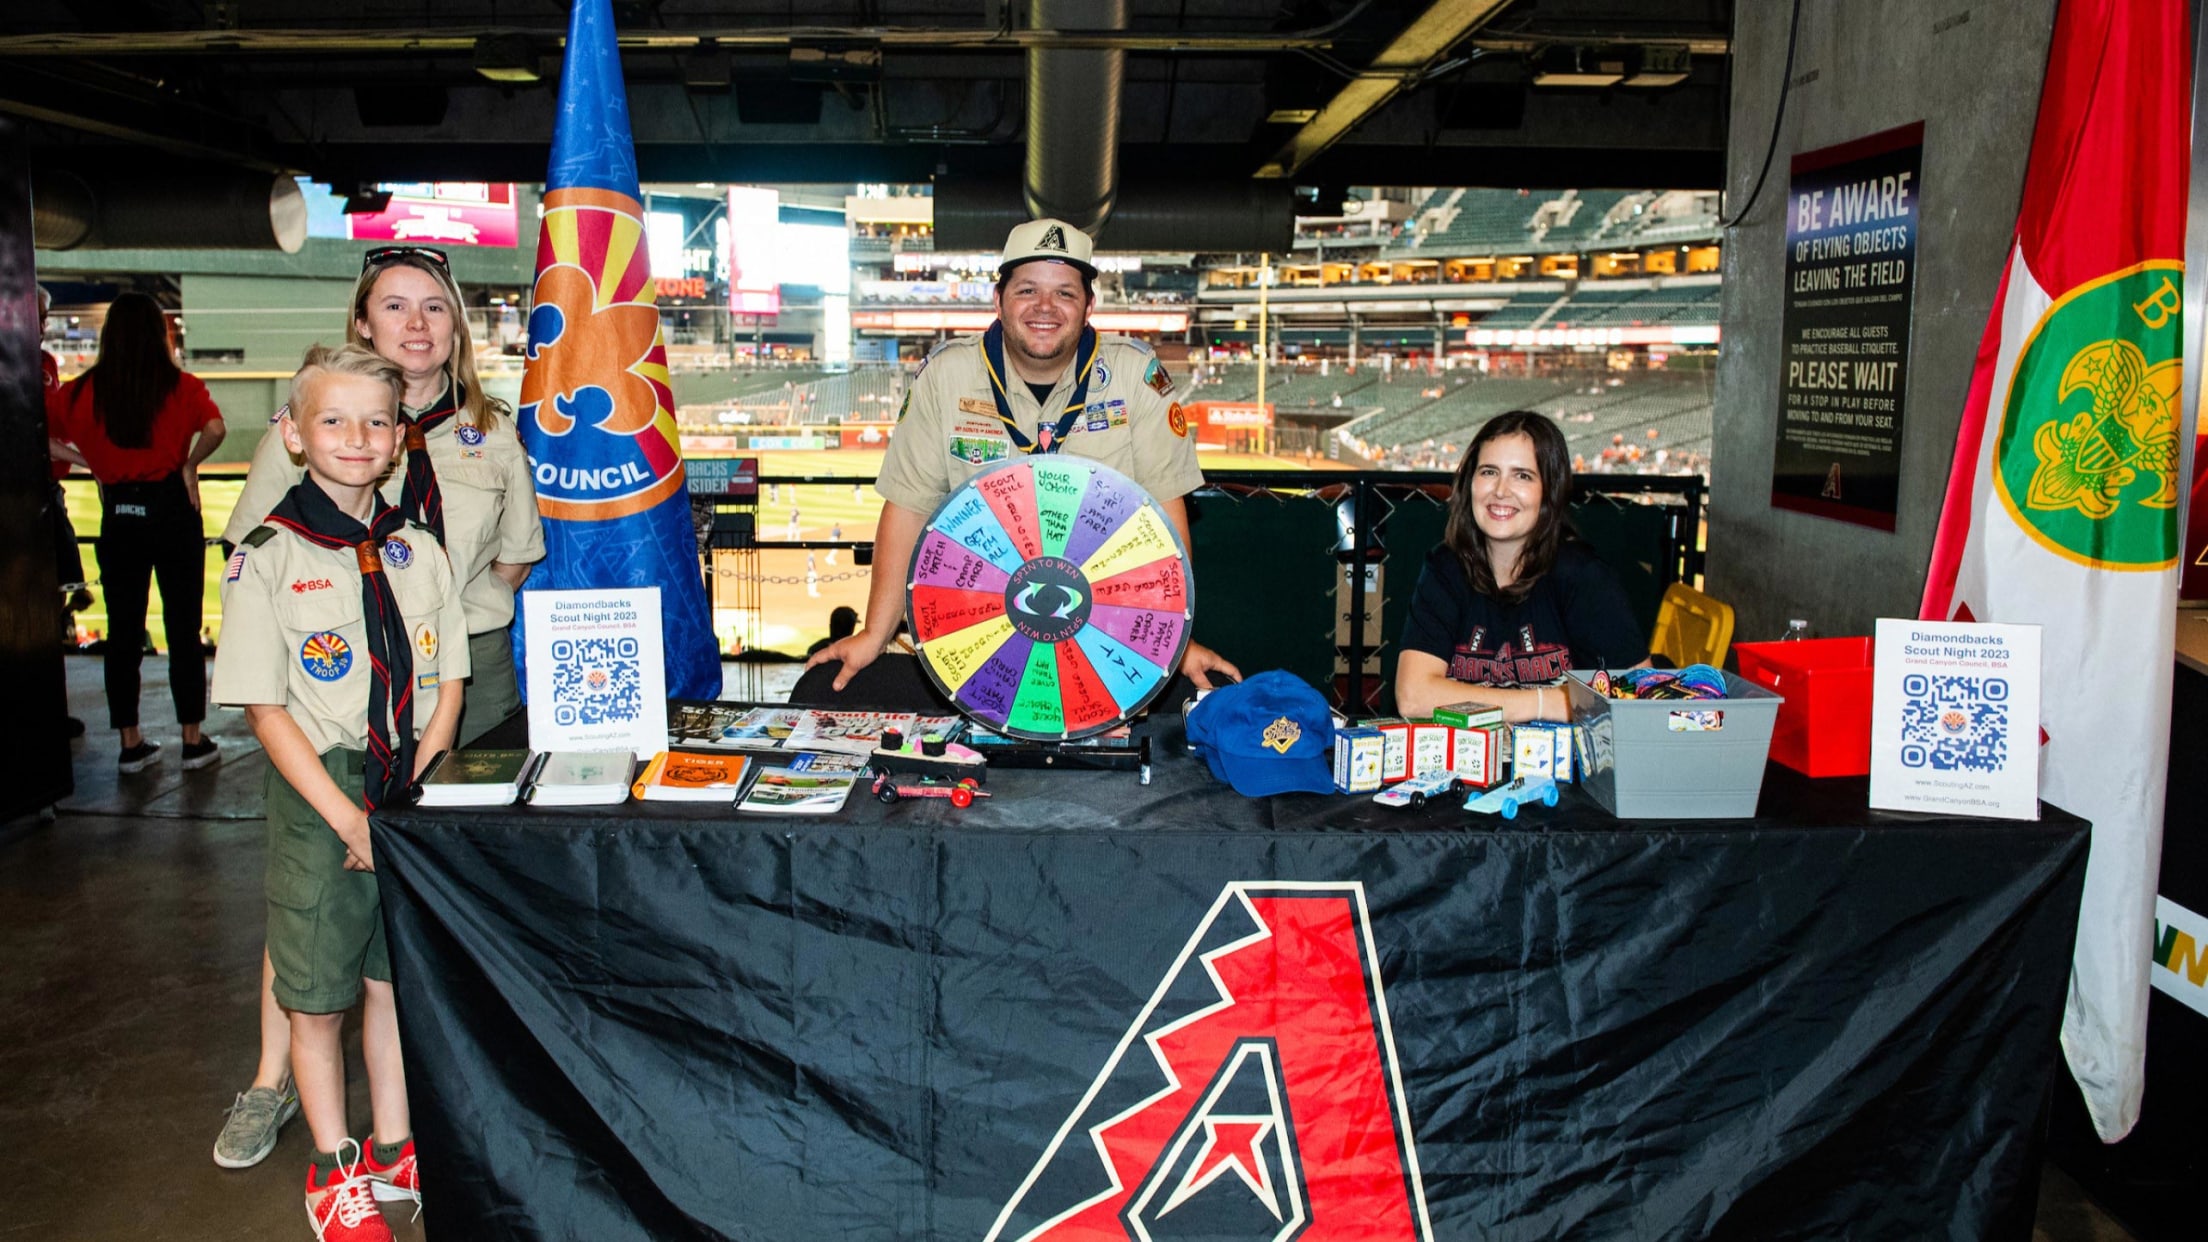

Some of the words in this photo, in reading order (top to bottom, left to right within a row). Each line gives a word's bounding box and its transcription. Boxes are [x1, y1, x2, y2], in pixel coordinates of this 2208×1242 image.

[1797, 190, 1824, 233] BE
[1829, 171, 1911, 228] AWARE
[1795, 240, 1809, 263] OF
[1812, 235, 1850, 261] FLYING
[1854, 225, 1907, 255] OBJECTS
[1794, 266, 1840, 293] LEAVING
[1844, 264, 1866, 289] THE
[1870, 259, 1905, 286] FIELD
[654, 277, 705, 297] ZONE
[1802, 328, 1811, 339] WE
[1812, 327, 1848, 339] ENCOURAGE
[1849, 327, 1861, 339] ALL
[1862, 326, 1889, 339] GUESTS
[1800, 343, 1827, 354] PRACTICE
[1828, 343, 1859, 354] BASEBALL
[1861, 342, 1899, 354] ETIQUETTE.
[1789, 361, 1849, 390] PLEASE
[1854, 362, 1898, 391] WAIT
[1788, 394, 1801, 405] FOR
[1803, 396, 1809, 406] A
[1810, 395, 1829, 407] STOP
[1831, 396, 1839, 408] IN
[1842, 397, 1861, 409] PLAY
[1863, 398, 1895, 412] BEFORE
[1787, 409, 1810, 422] MOVING
[1811, 411, 1819, 422] TO
[1820, 411, 1834, 424] AND
[1835, 412, 1854, 425] FROM
[1855, 414, 1874, 427] YOUR
[1875, 416, 1894, 429] SEAT.
[687, 460, 728, 477] BACKS
[983, 473, 1016, 491] SCOUT
[1038, 470, 1071, 487] YOUR
[1045, 481, 1078, 496] CHOICE
[939, 498, 986, 534] WINNER
[1040, 509, 1069, 522] OTHER
[1045, 519, 1067, 531] THAN
[964, 526, 987, 547] GET
[1046, 528, 1066, 542] HAT
[988, 547, 1009, 563] ALL
[955, 554, 970, 588] CAMP
[967, 560, 984, 588] CARD
[1013, 562, 1037, 585] SPIN
[1038, 559, 1053, 568] TO
[1057, 560, 1080, 580] WIN
[308, 579, 334, 591] BSA
[555, 599, 632, 610] Diamondbacks
[550, 613, 581, 623] Scout
[583, 612, 611, 624] Night
[613, 611, 637, 621] 2023
[1017, 620, 1040, 640] WIN
[1060, 616, 1083, 638] SPIN
[1042, 632, 1059, 642] TO
[1911, 631, 2004, 645] Diamondbacks
[1904, 645, 1941, 656] Scout
[1943, 647, 1977, 660] Night
[1980, 648, 2010, 659] 2023
[310, 663, 340, 677] TROOP
[1100, 644, 1143, 685] HAT
[1515, 650, 1573, 683] RACE
[1905, 657, 1928, 665] Grand
[1929, 658, 1958, 667] Canyon
[1991, 661, 2008, 669] BSA
[810, 710, 869, 719] Scout
[873, 712, 911, 720] Life
[684, 757, 725, 766] TIGER
[1915, 779, 1991, 791] www.ScoutingAZ.com
